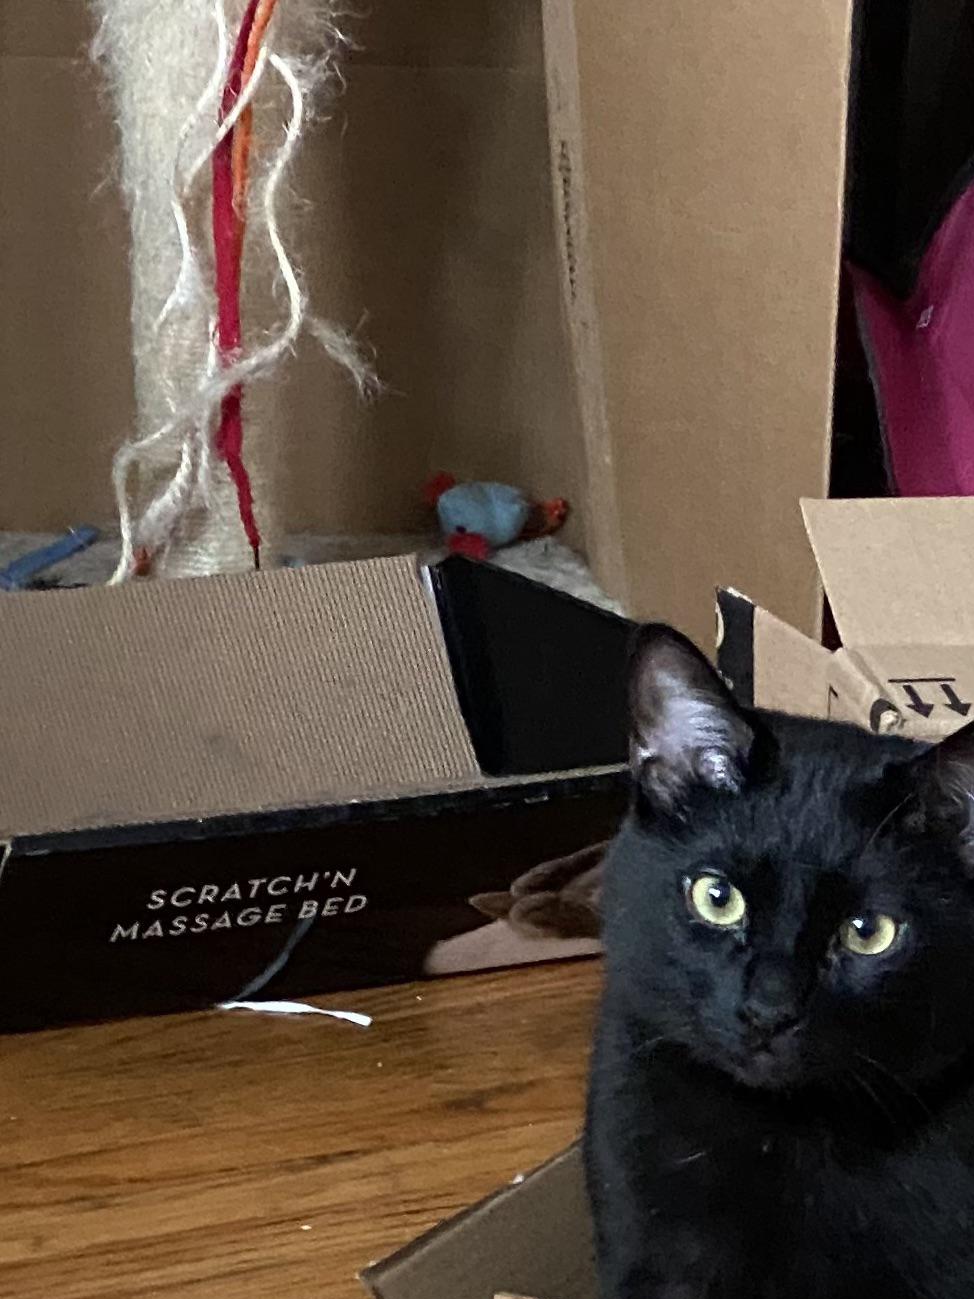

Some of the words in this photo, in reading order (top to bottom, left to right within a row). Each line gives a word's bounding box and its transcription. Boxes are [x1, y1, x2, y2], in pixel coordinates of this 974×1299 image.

[147, 868, 357, 910] SCRATCH'N
[109, 904, 287, 943] MASSAGE
[298, 895, 368, 920] BED
